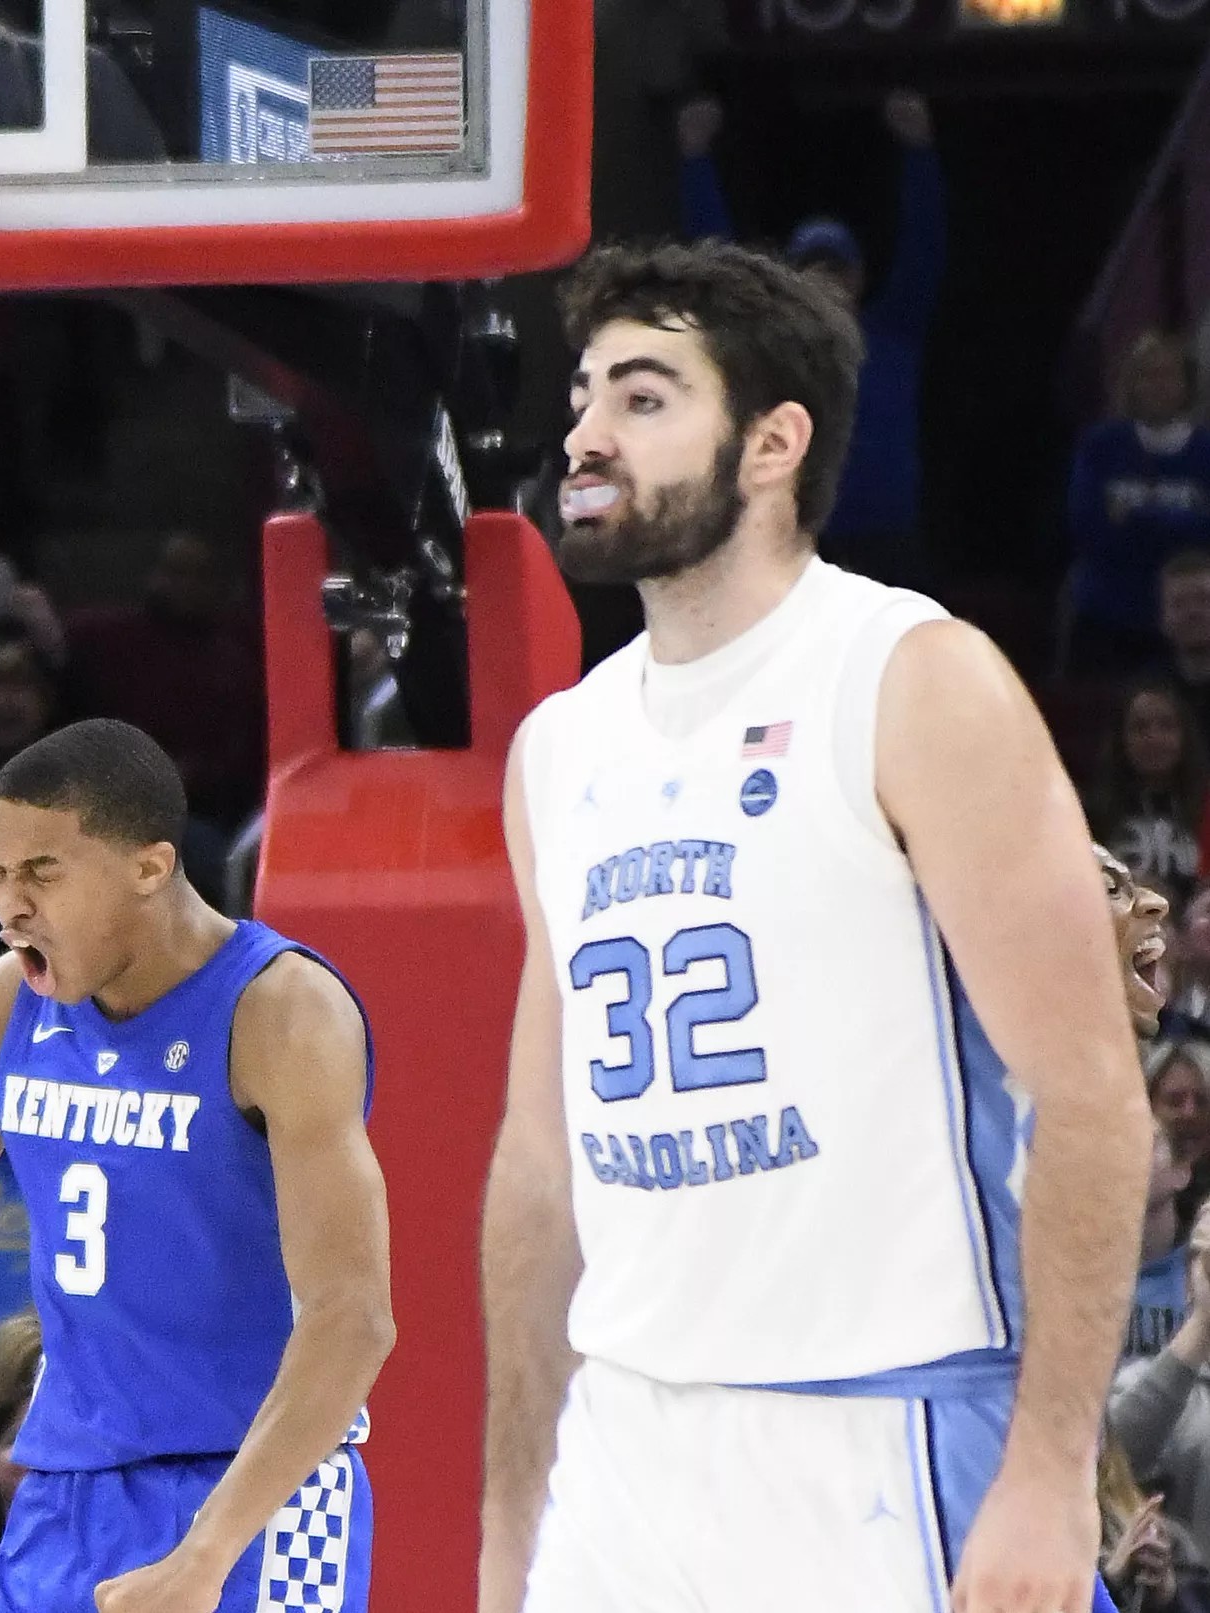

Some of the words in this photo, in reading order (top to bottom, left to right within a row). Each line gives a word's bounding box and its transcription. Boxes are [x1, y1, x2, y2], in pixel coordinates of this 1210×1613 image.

[581, 839, 736, 922] NORTH
[569, 922, 767, 1103] 32
[1, 1075, 201, 1152] KENTUCKY
[582, 1106, 819, 1191] CAROLINA
[54, 1163, 108, 1297] 3
